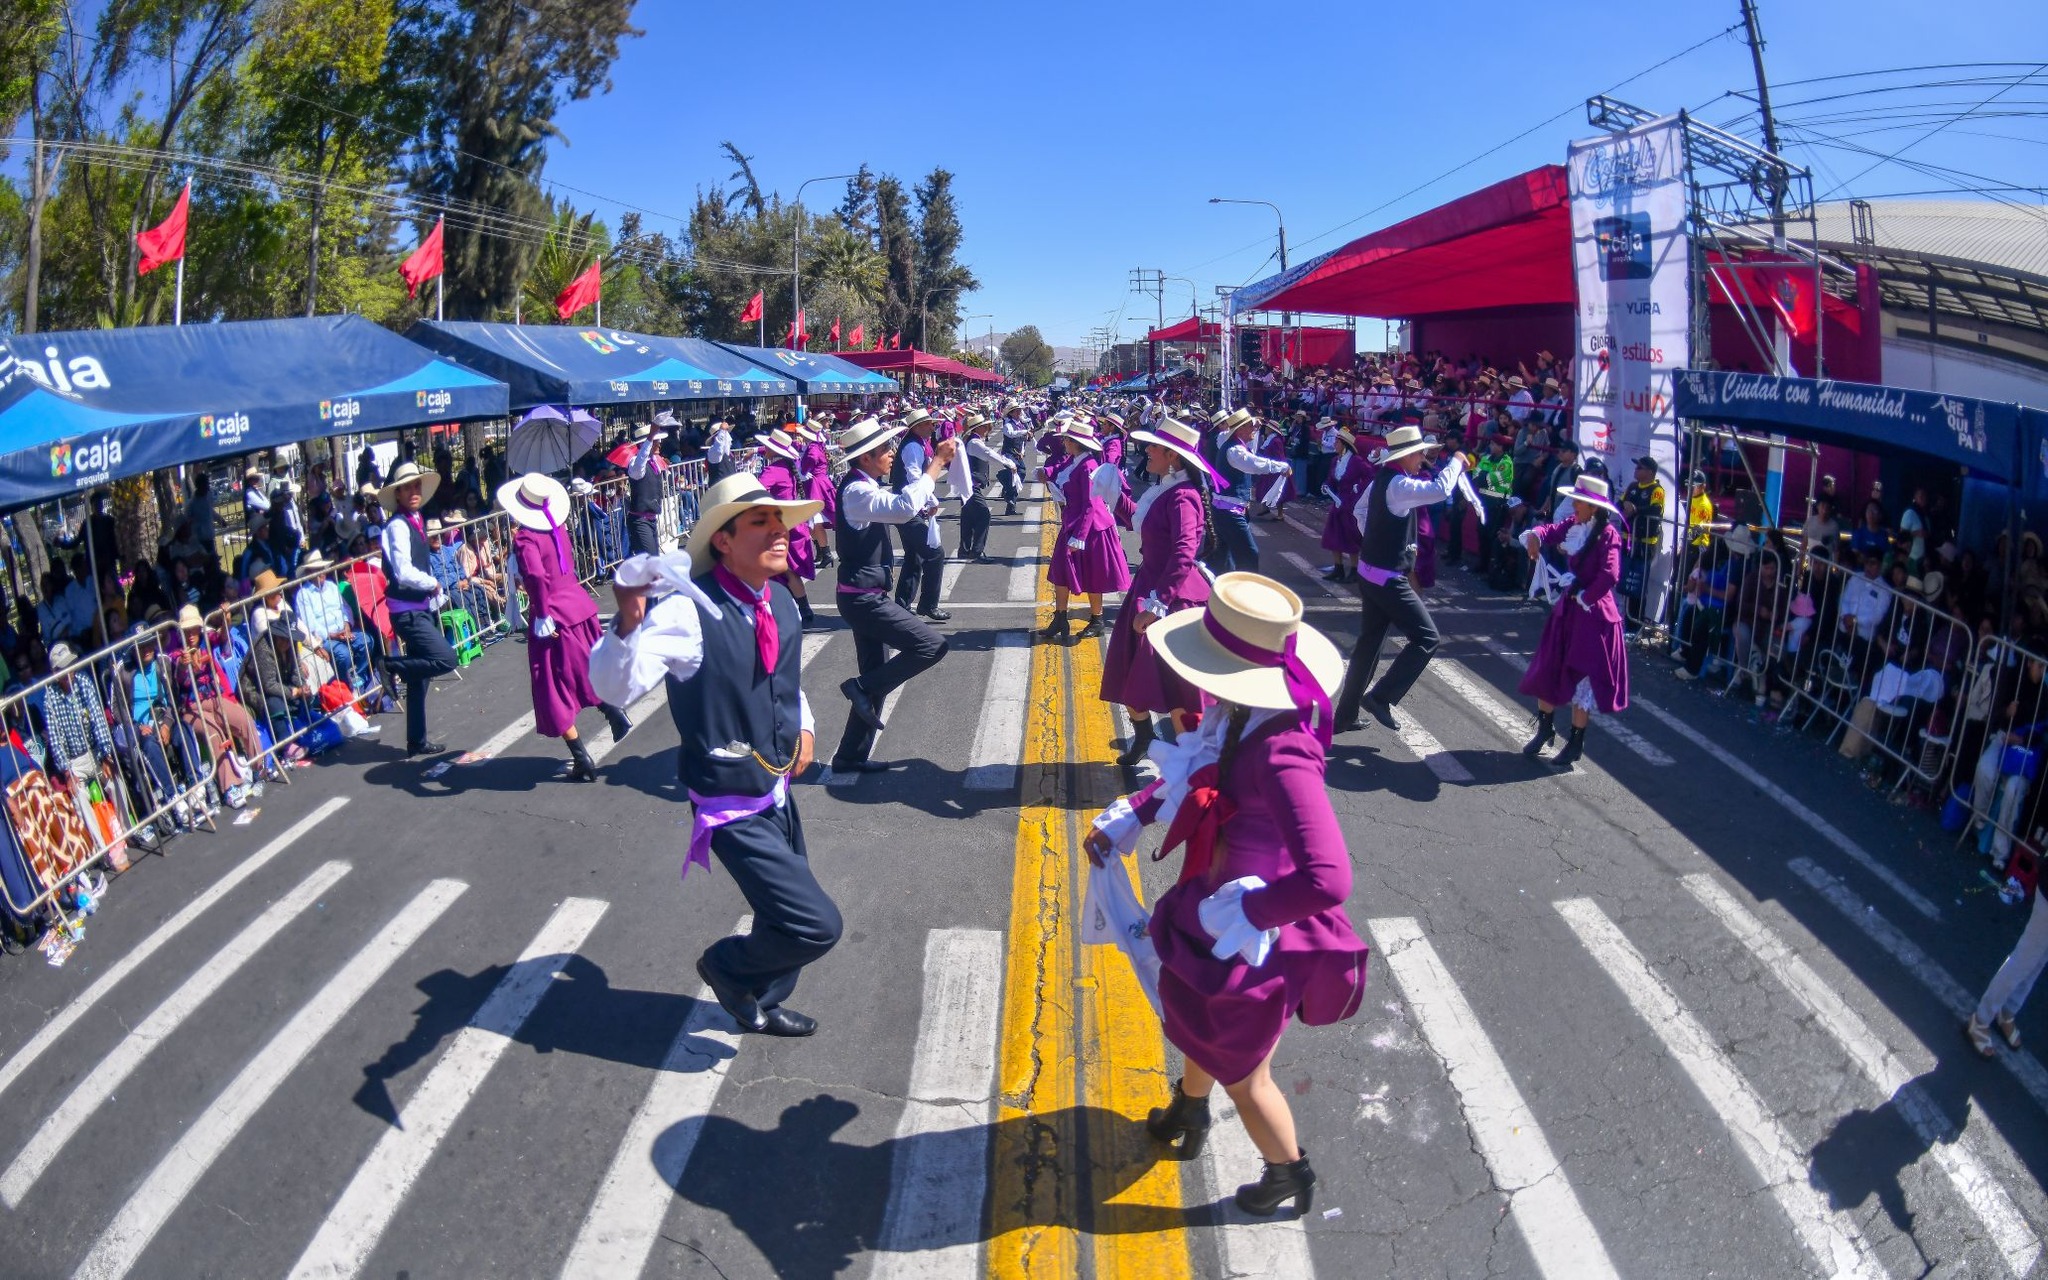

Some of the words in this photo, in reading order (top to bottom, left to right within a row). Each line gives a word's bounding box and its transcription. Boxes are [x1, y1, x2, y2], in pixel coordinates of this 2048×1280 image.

[1612, 230, 1643, 254] caja
[1626, 303, 1661, 315] YURA
[1590, 335, 1618, 353] GLORIA
[1622, 342, 1664, 364] estilos
[428, 390, 451, 408] caja
[1623, 386, 1665, 415] win
[1722, 372, 1780, 404] Ciudad
[1785, 385, 1810, 405] con
[1818, 380, 1905, 419] Humanidad
[333, 399, 360, 418] caja
[1931, 396, 1964, 417] ARE
[217, 411, 250, 436] caja
[1947, 413, 1968, 433] QUI
[1958, 433, 1973, 450] PA
[75, 436, 122, 471] caja
[76, 471, 110, 487] arequipa
